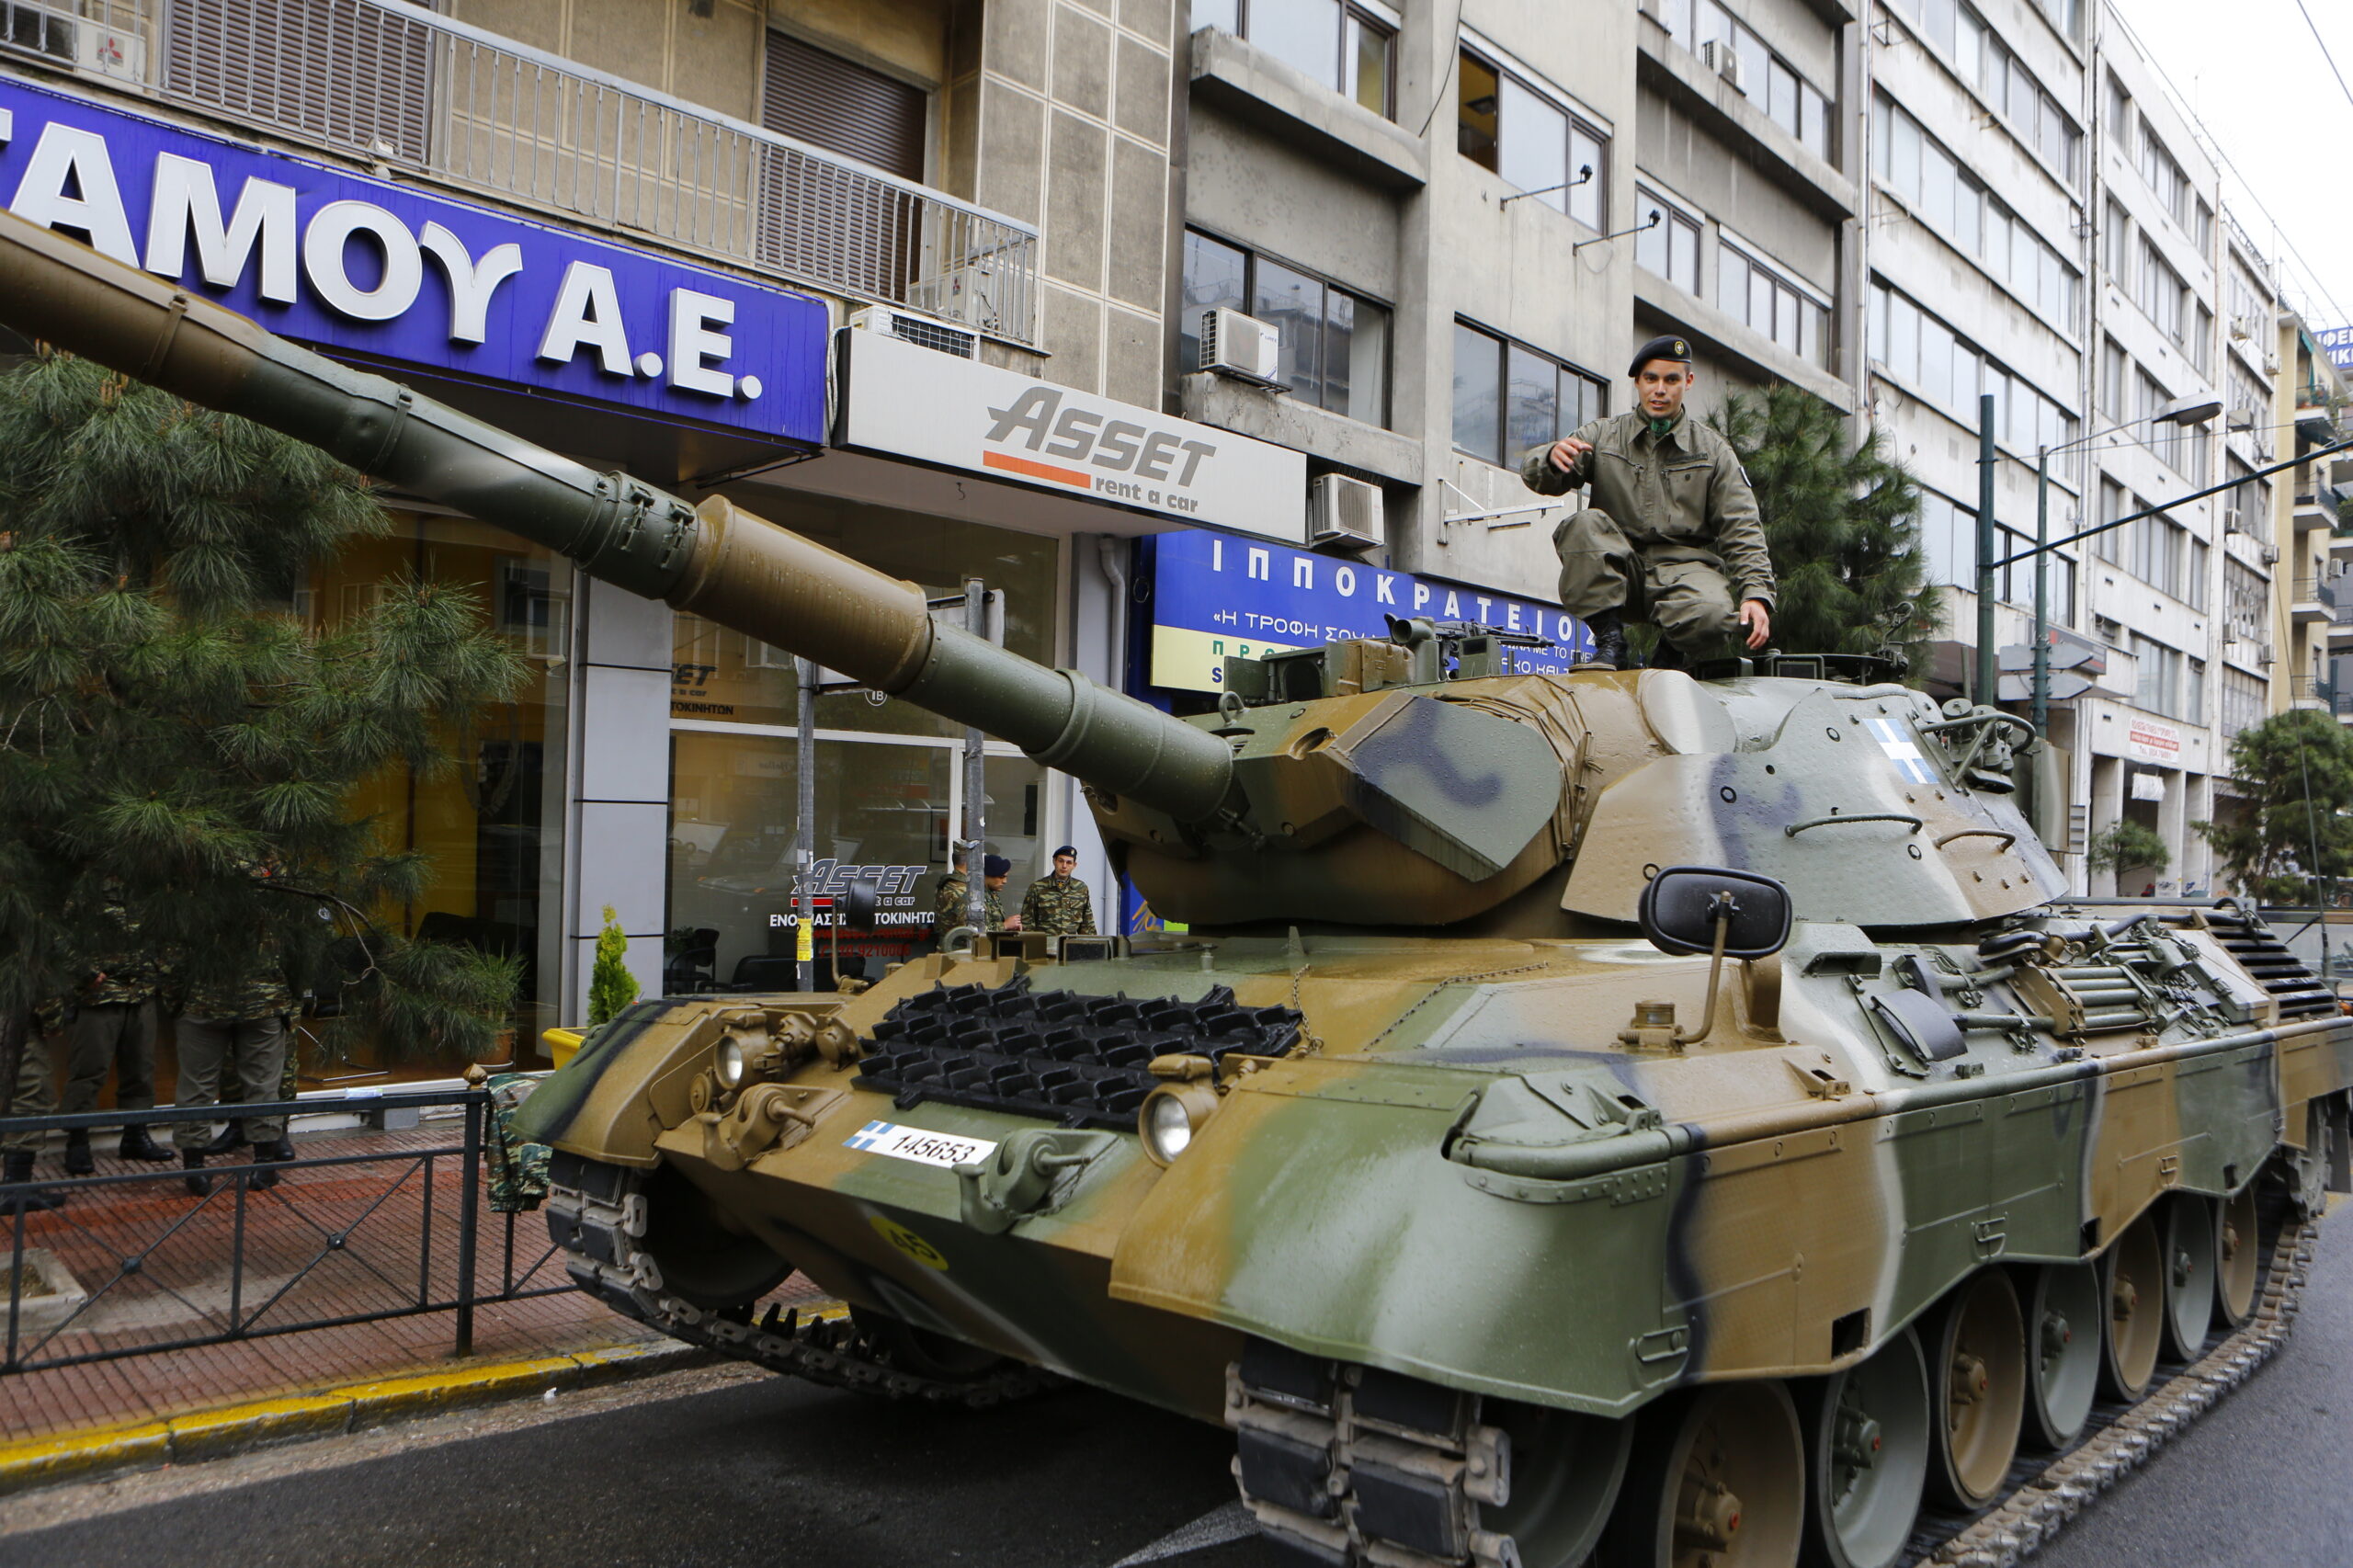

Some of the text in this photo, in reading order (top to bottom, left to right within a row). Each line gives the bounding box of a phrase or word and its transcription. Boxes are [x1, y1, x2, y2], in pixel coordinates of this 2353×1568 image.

[0, 108, 523, 344] ΑΜΟΥ
[1096, 475, 1199, 514] rent a car
[1245, 612, 1318, 639] ΤΡΟΦΗ
[894, 896, 915, 906] car
[892, 1134, 976, 1165] 145653
